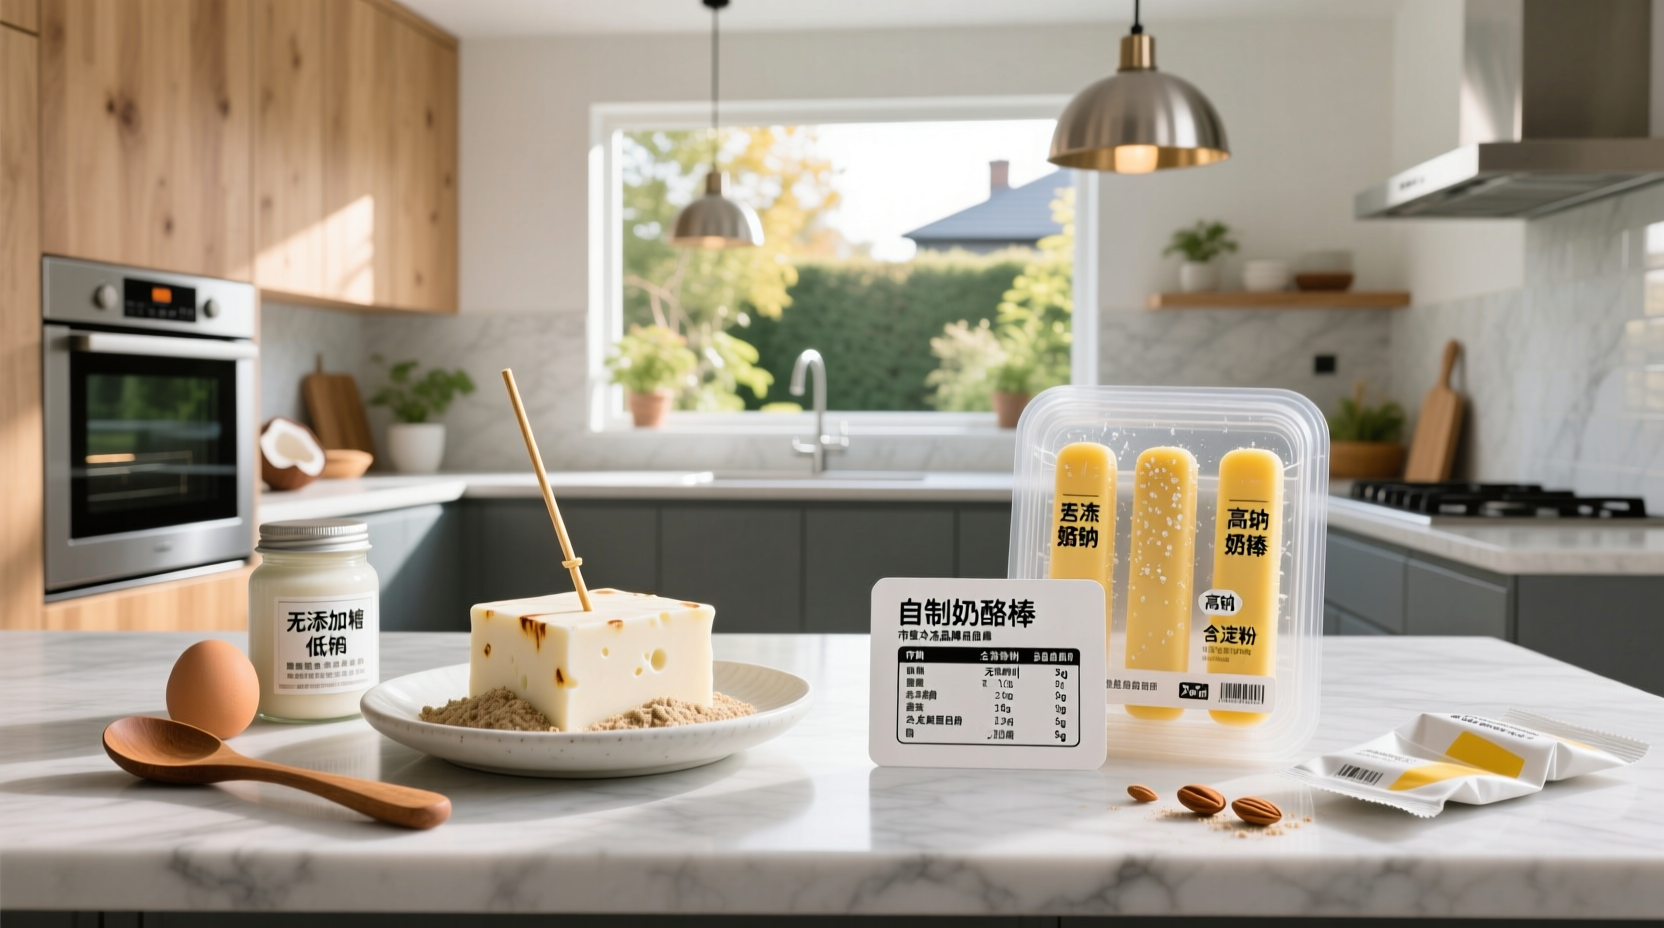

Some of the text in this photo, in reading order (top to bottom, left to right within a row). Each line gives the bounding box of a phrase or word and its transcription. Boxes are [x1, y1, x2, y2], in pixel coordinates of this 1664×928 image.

[287, 609, 365, 633] 无添加糖
[899, 597, 1036, 629] 自制奶酪棒
[1203, 624, 1257, 646] 含淀粉
